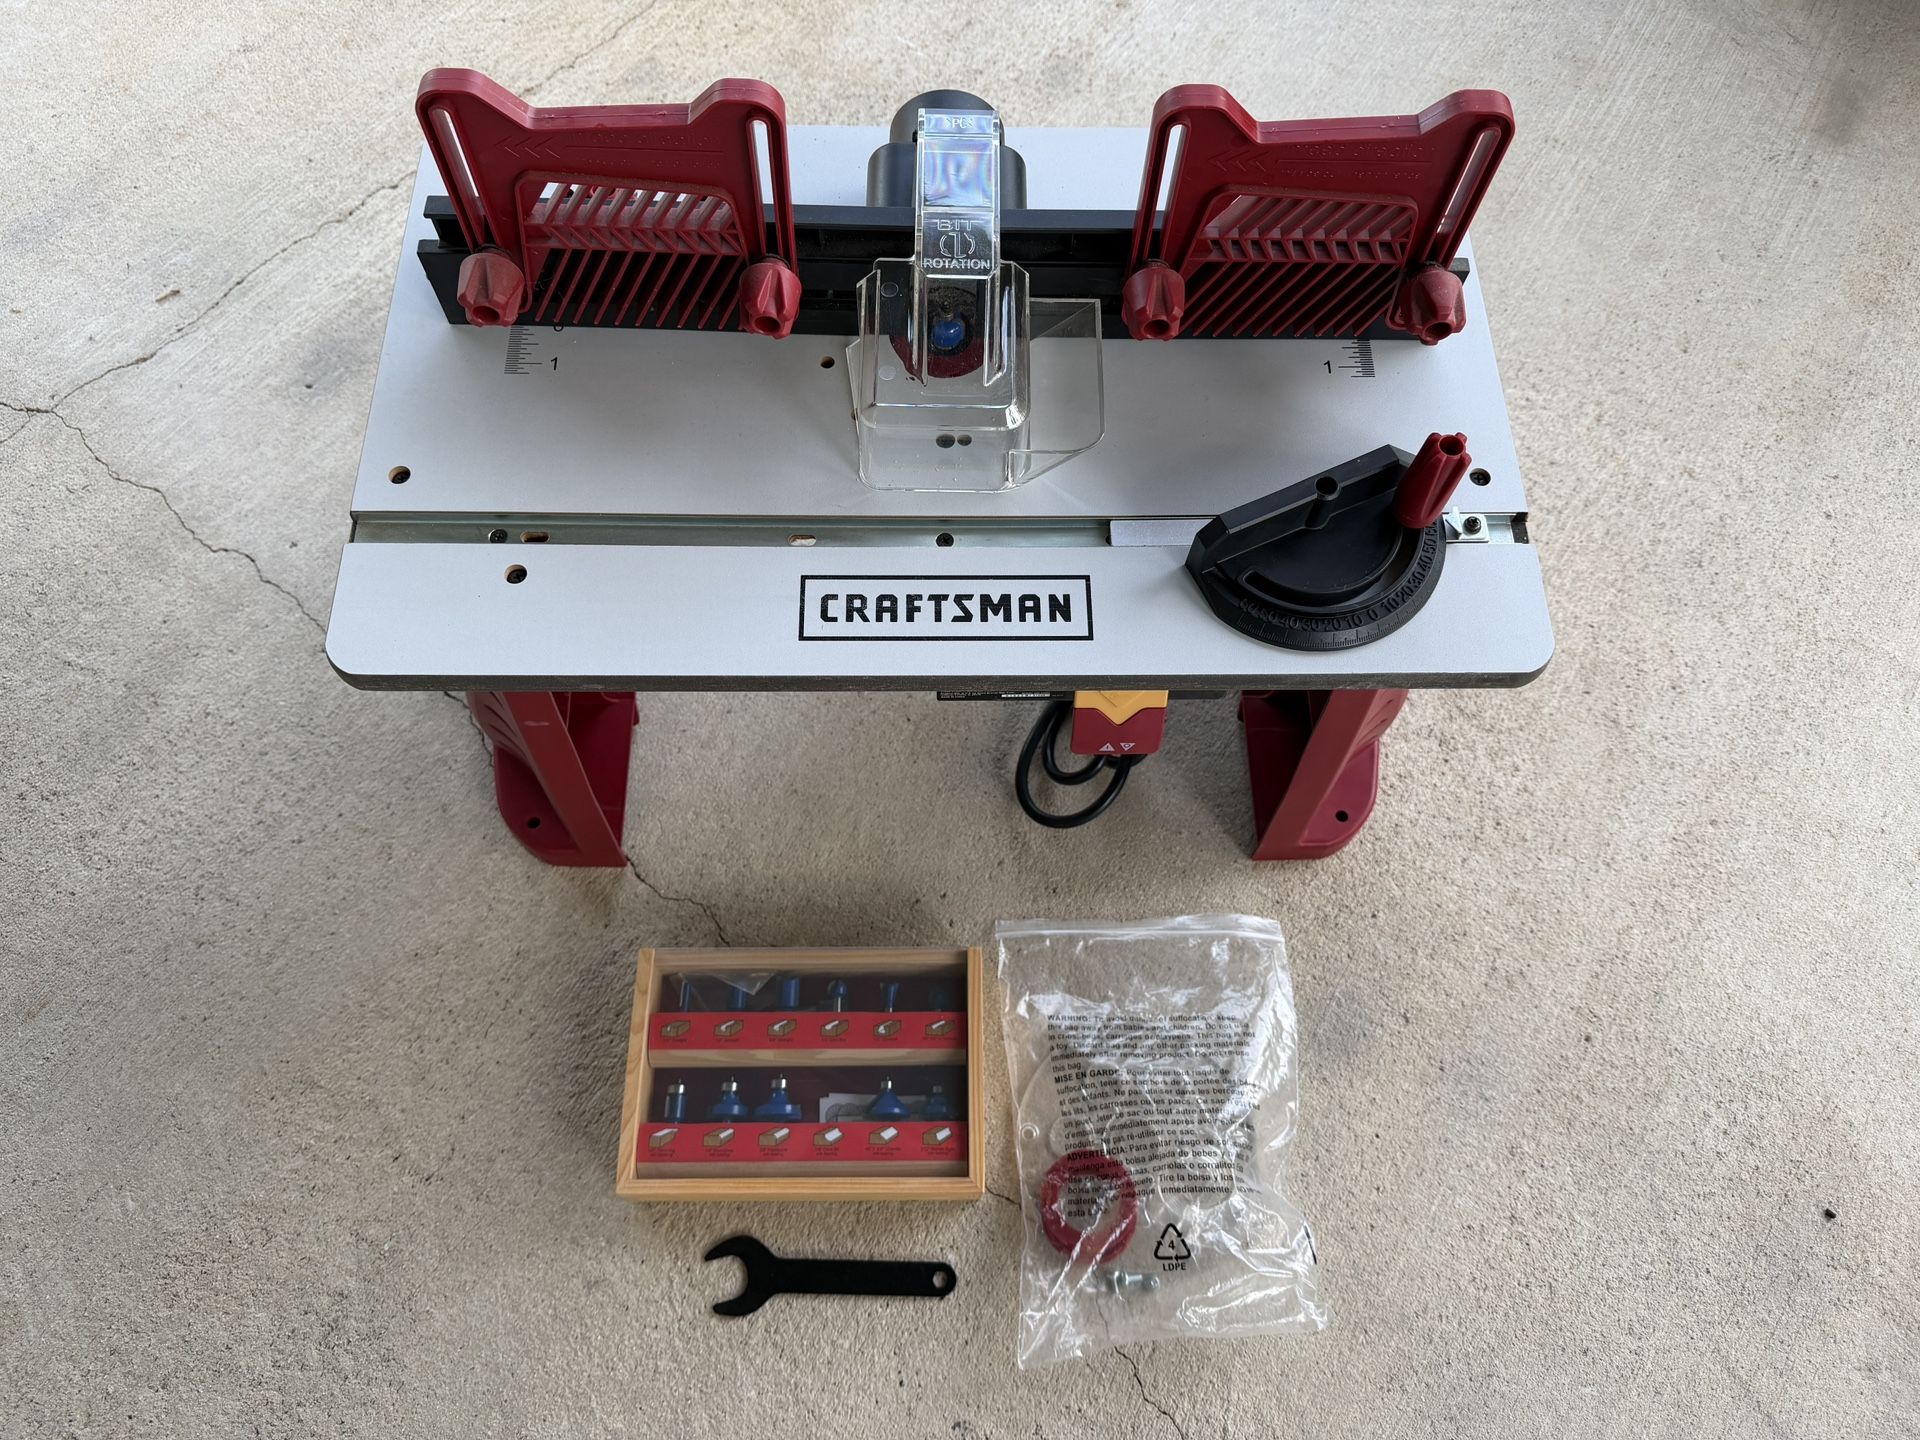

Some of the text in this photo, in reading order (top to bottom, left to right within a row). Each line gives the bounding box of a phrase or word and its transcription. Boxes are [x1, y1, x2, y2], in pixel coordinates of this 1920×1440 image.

[937, 219, 972, 231] BIT
[923, 257, 990, 270] ROTATION
[550, 356, 558, 371] 1
[1323, 360, 1332, 374] 1
[1421, 540, 1438, 555] 50
[1417, 556, 1433, 571] 40
[1407, 571, 1426, 588] 30
[1396, 586, 1414, 603] 20
[819, 593, 1072, 623] CRAFTSMAN
[1381, 597, 1400, 613] 10
[1345, 614, 1364, 628] 10
[1367, 608, 1379, 621] 0
[1054, 1073, 1073, 1083] MISE
[1075, 1071, 1087, 1079] EN
[1067, 1147, 1127, 1161] ADVERTENCIA:
[1129, 1142, 1148, 1152] Para
[1167, 1240, 1176, 1250] 4
[1162, 1262, 1187, 1272] LDPE
